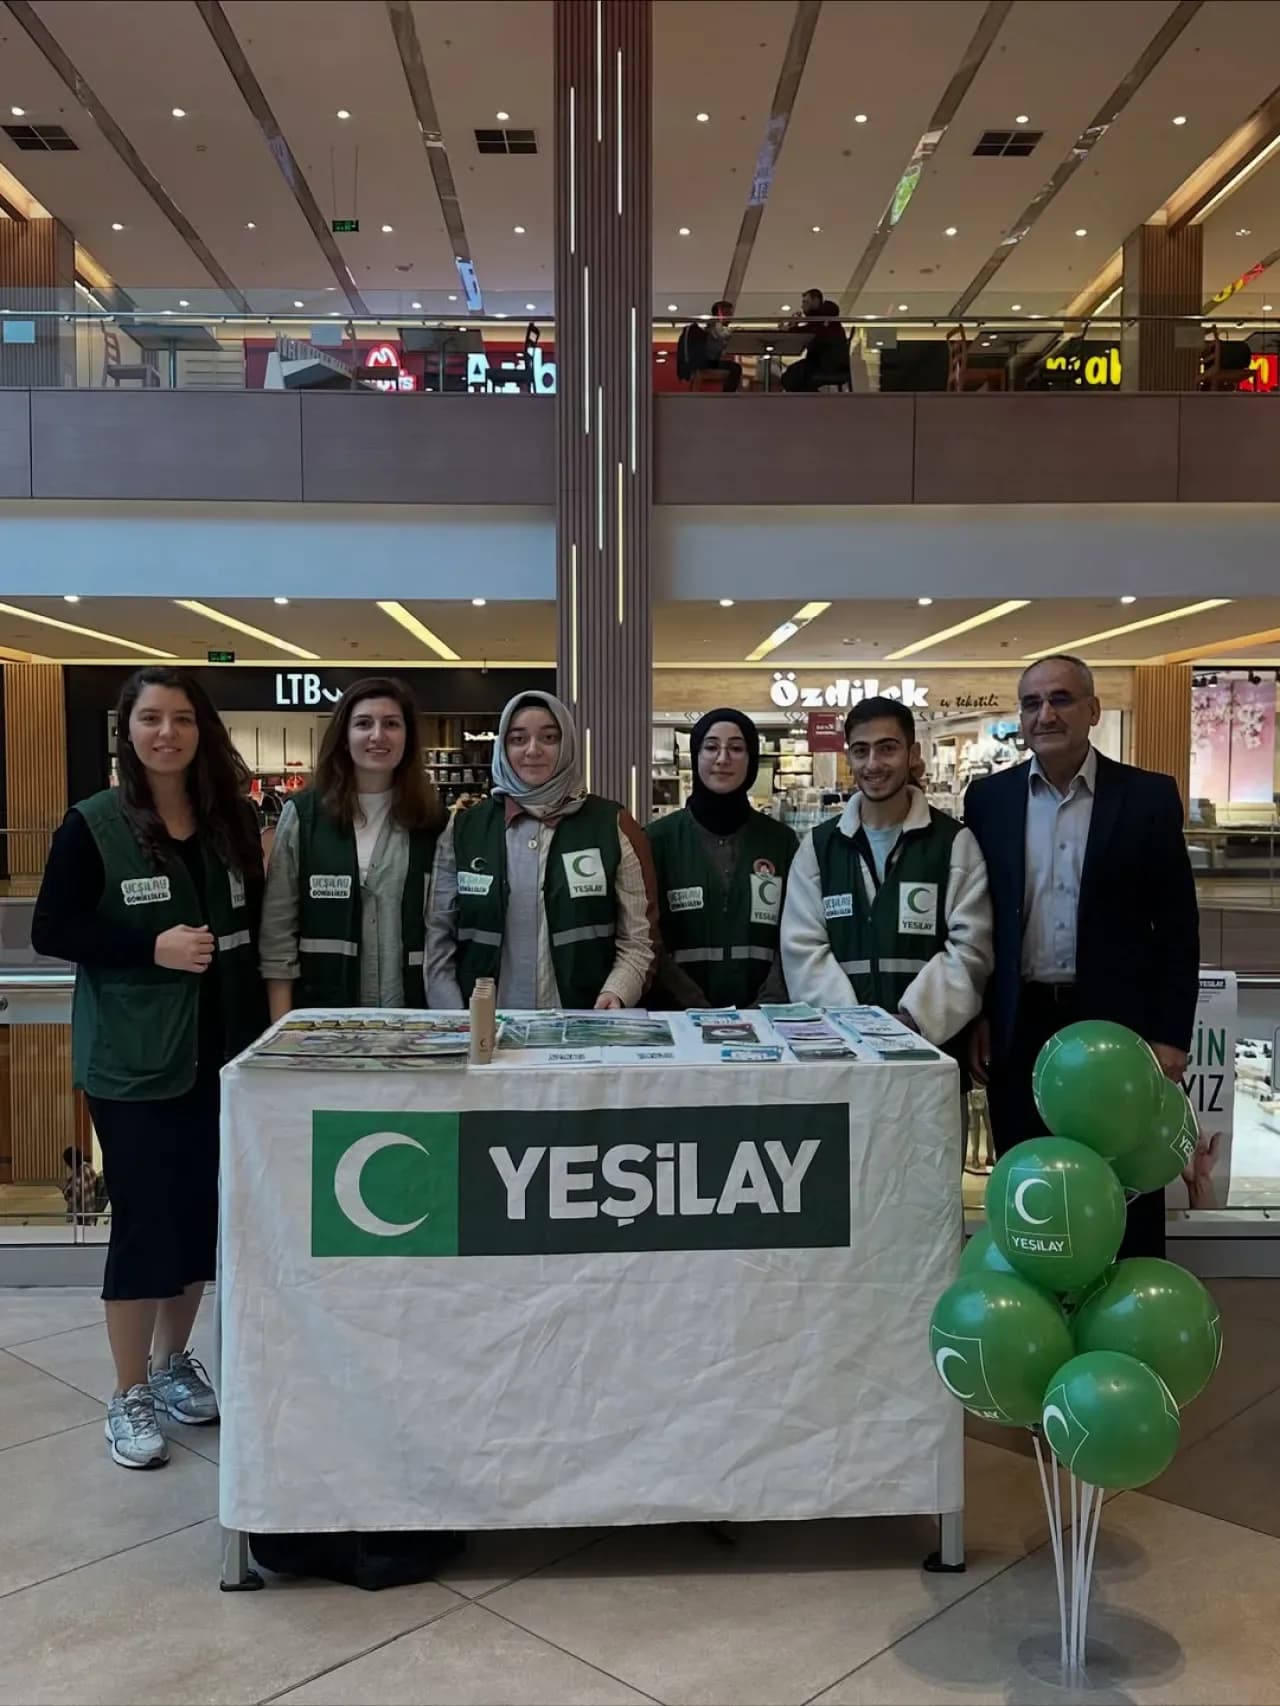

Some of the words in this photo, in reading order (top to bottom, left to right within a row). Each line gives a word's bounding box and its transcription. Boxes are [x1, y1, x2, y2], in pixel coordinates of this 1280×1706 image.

[276, 673, 321, 705] LTB
[770, 672, 929, 707] Özdilek
[1189, 1020, 1226, 1066] İN
